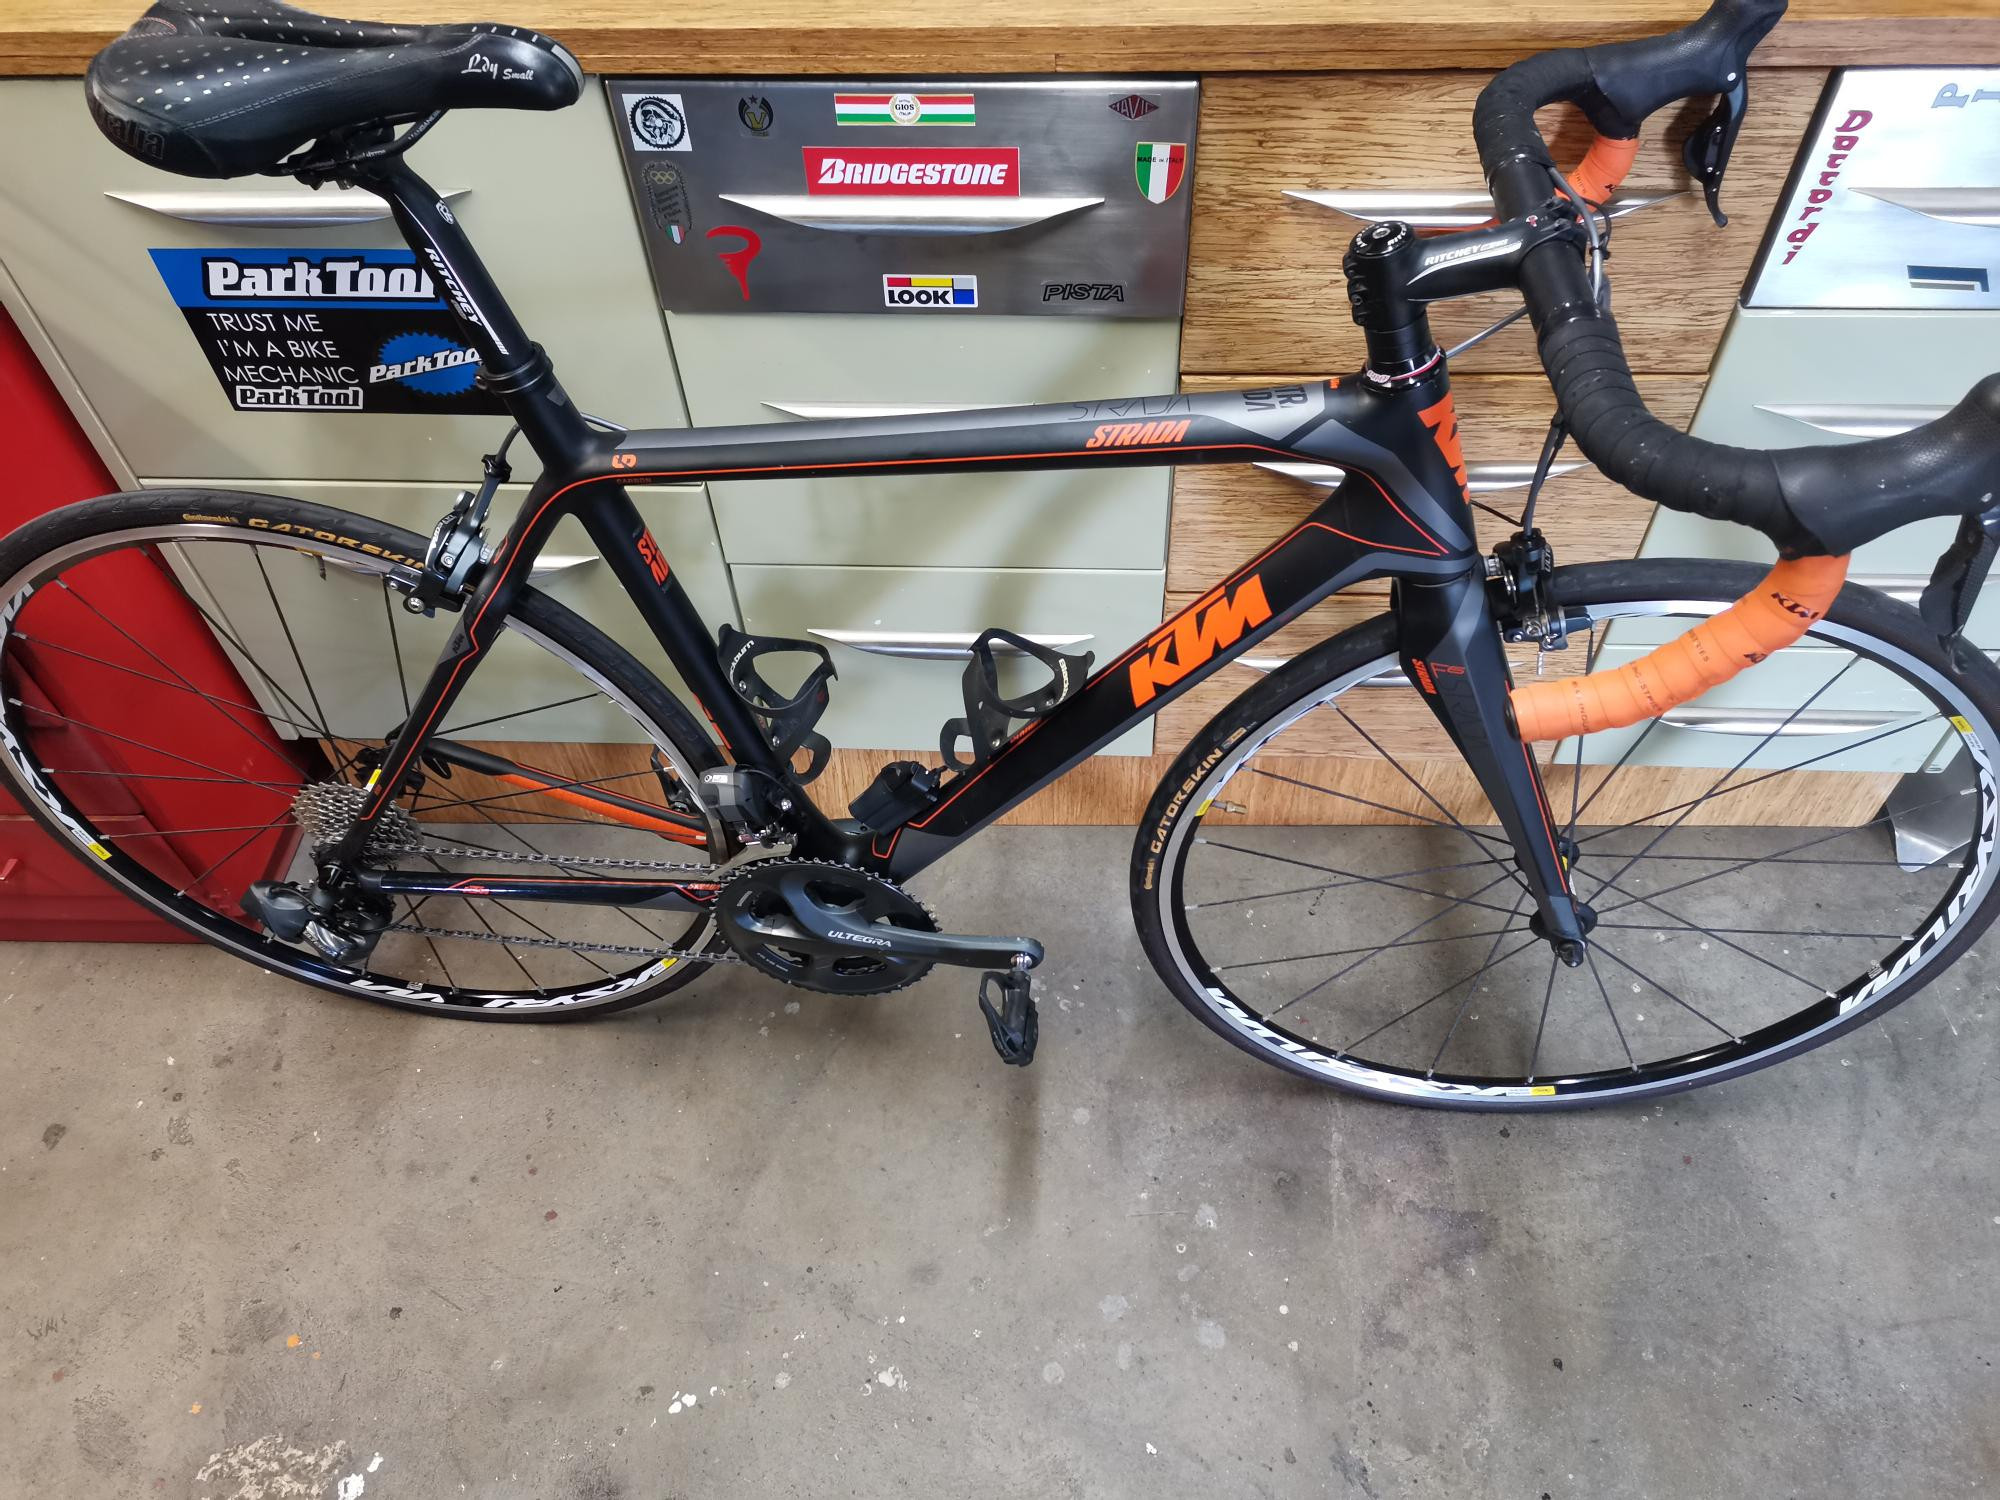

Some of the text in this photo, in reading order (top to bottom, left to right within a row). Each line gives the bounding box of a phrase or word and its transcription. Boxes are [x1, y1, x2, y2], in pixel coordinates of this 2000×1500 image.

[894, 103, 915, 111] GIOS
[818, 158, 1009, 185] BRIDGESTONE
[1424, 243, 1481, 266] RITCHEY
[424, 247, 483, 327] RITCHEY
[888, 289, 951, 305] LOOK
[1042, 283, 1125, 302] PISTA
[206, 313, 324, 332] TRUST ME
[216, 339, 340, 359] I'M A BIKE
[223, 365, 360, 384] MECHANIC
[369, 347, 483, 384] ParkToo
[1086, 419, 1191, 448] STRADA
[1129, 574, 1273, 709] KTM
[1151, 747, 1224, 854] GATORSKIN
[827, 930, 892, 948] ULTEGRA
